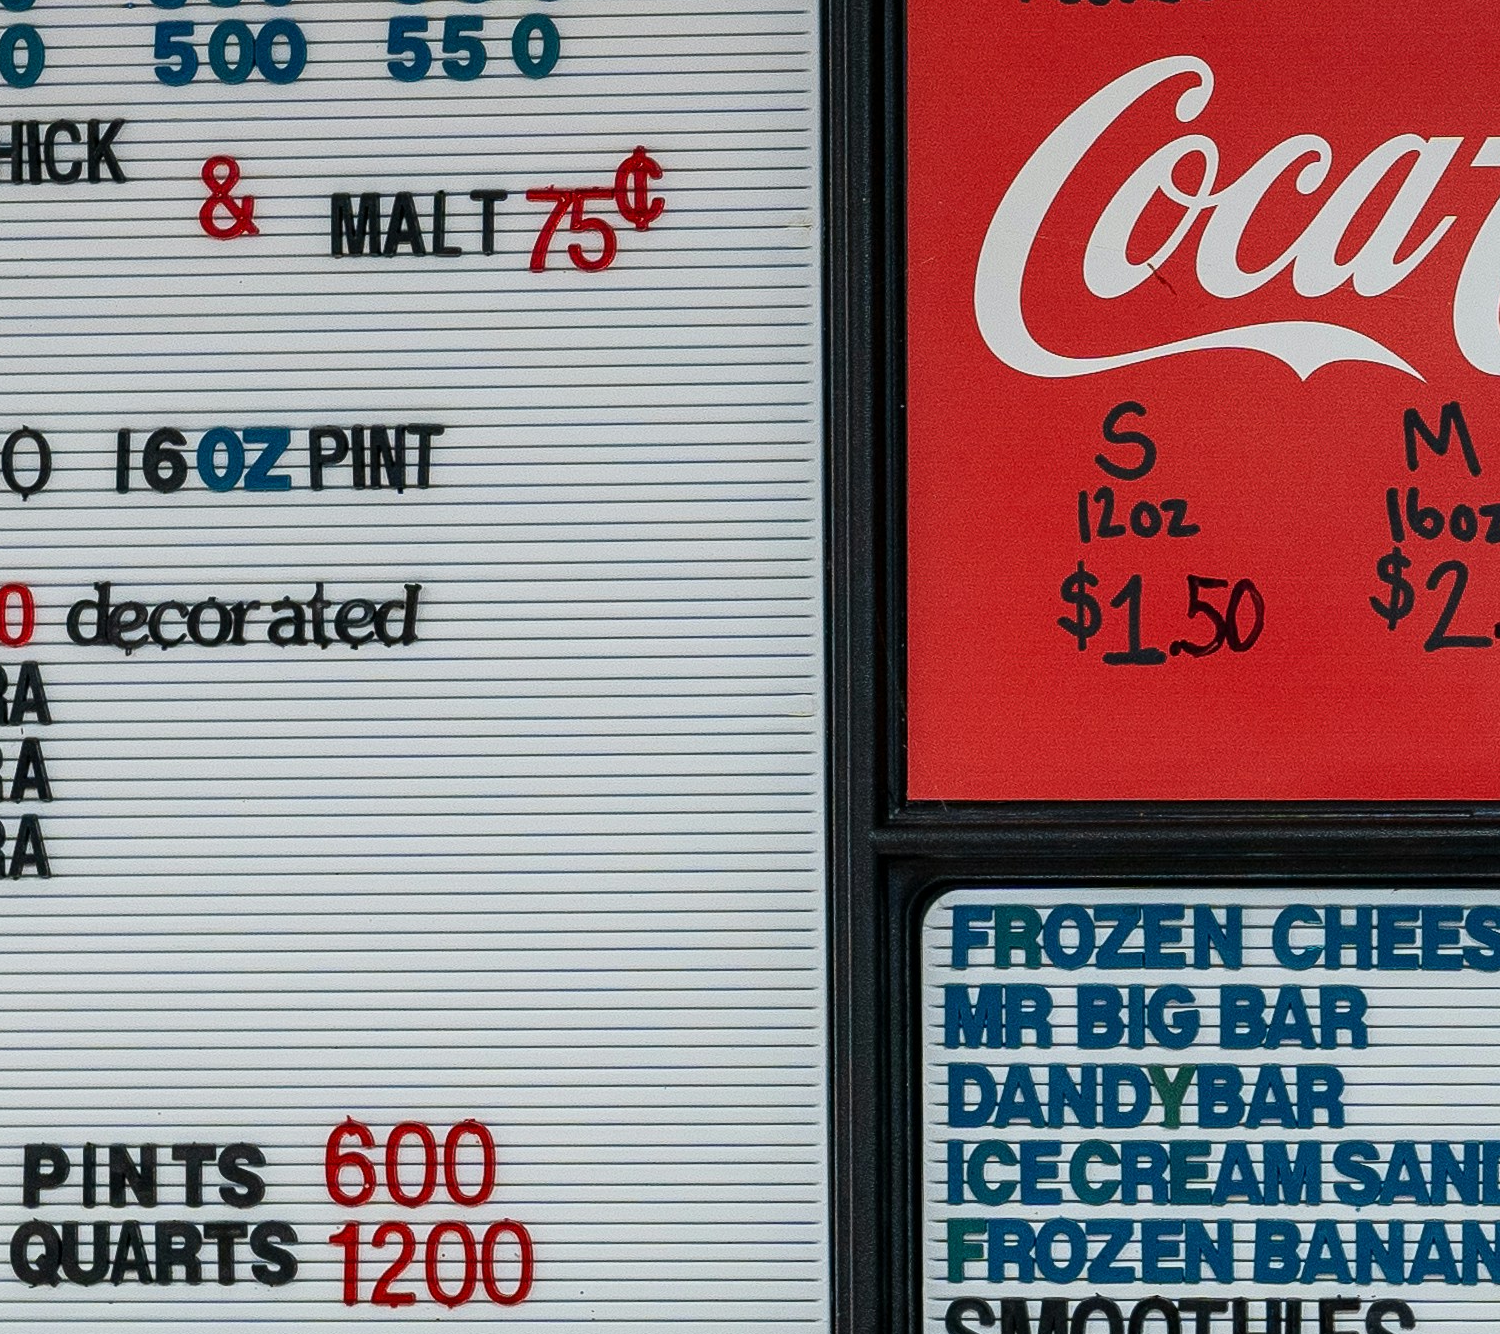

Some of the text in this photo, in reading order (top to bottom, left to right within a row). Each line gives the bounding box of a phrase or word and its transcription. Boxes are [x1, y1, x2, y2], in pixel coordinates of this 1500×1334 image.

[154, 17, 307, 87] 500
[198, 155, 259, 242] &
[330, 188, 509, 258] MALT
[309, 423, 445, 494] PINT
[1095, 400, 1157, 480] S
[1403, 402, 1482, 477] M
[1076, 489, 1200, 543] 12oz
[66, 581, 423, 655] decorated
[1057, 562, 1265, 665] $1.50
[951, 905, 1243, 972] FROZEN
[943, 983, 1369, 1051] MR BIG BAR
[23, 1116, 497, 1209] PINTS 600
[10, 1218, 533, 1307] QUARTS 1200
[946, 1220, 1234, 1286] FROZEN
